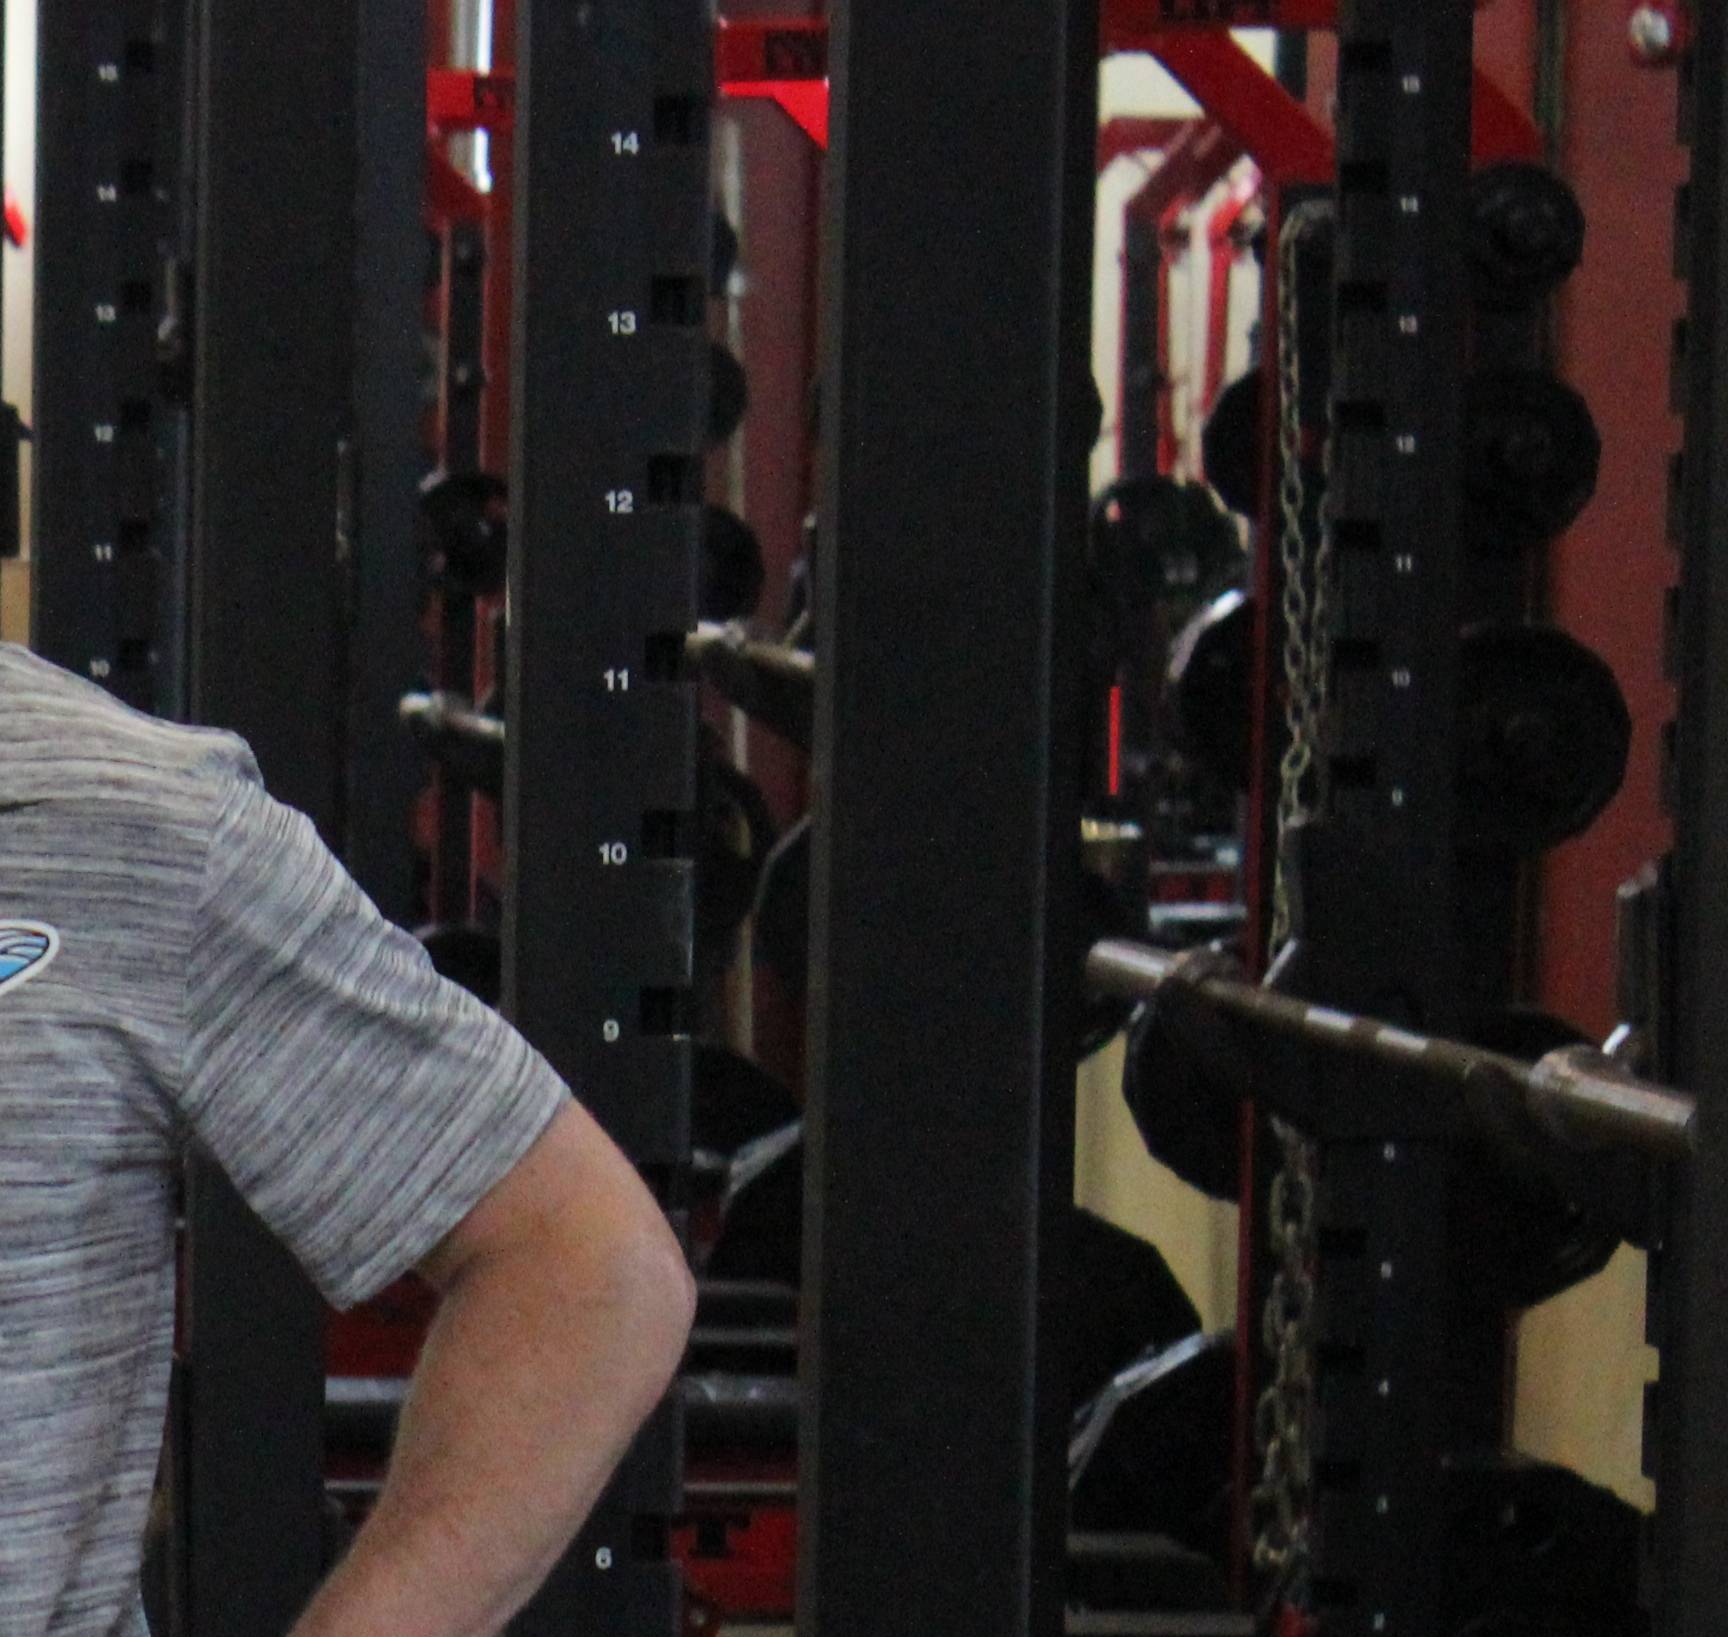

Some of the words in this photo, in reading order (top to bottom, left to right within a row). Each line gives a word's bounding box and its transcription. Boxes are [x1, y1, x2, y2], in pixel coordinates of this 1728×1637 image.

[611, 131, 639, 155] 14
[608, 311, 637, 335] 13
[605, 489, 633, 513] 12
[603, 669, 629, 691] 11
[599, 842, 628, 865] 10
[602, 1019, 620, 1042] 9
[595, 1547, 612, 1570] 6
